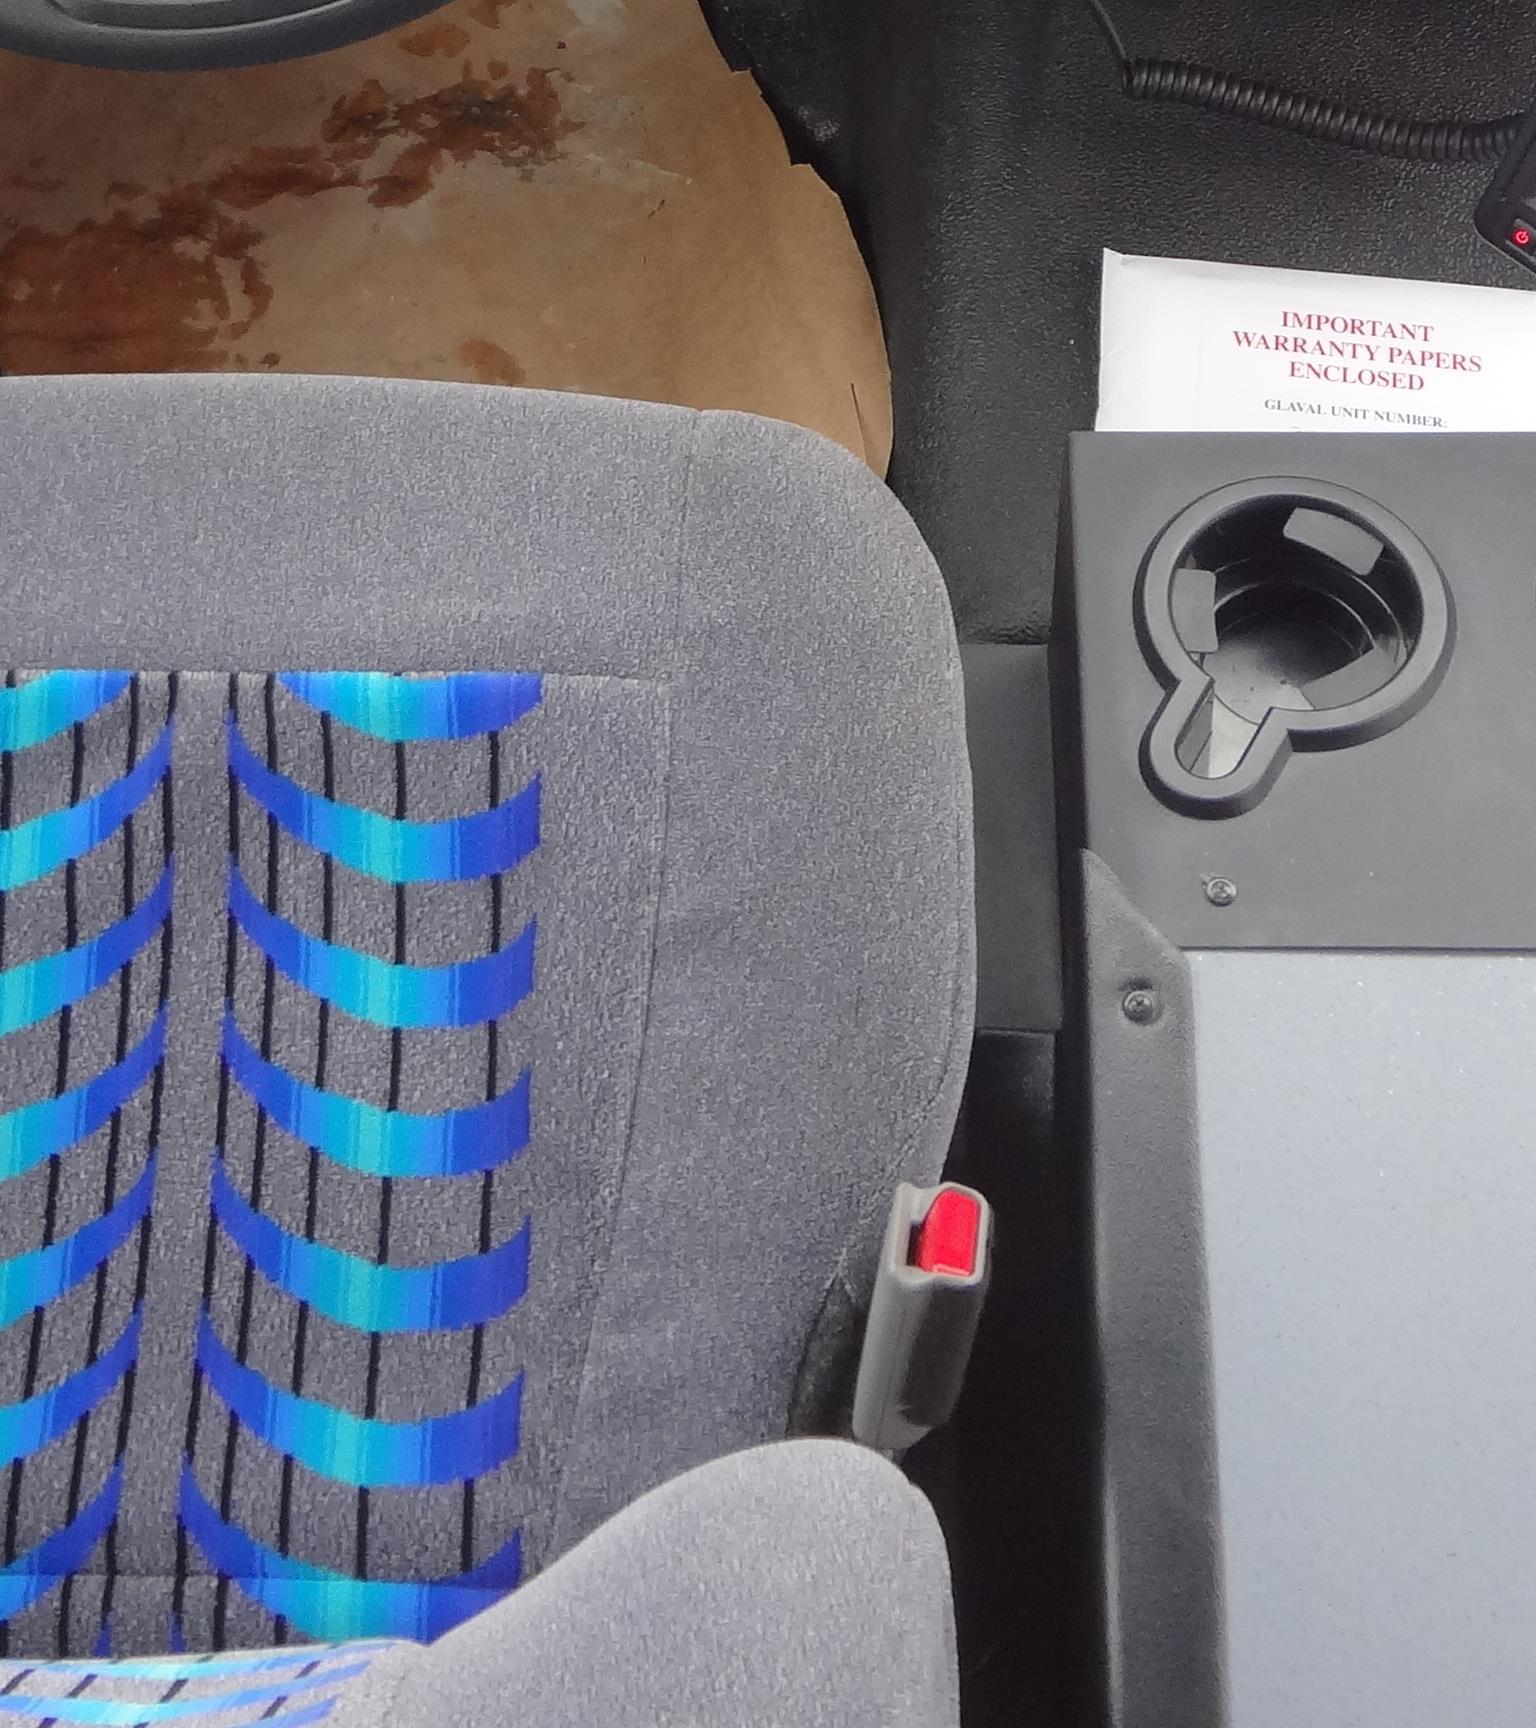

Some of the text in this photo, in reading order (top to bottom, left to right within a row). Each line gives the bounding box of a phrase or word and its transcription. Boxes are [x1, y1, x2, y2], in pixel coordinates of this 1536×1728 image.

[1280, 310, 1435, 344] IMPORTANT
[1232, 329, 1483, 373] WARRANTY PAPERS
[1288, 360, 1426, 392] ENCLOSED
[1264, 398, 1449, 429] GLAVAL UNIT NUMBER:
